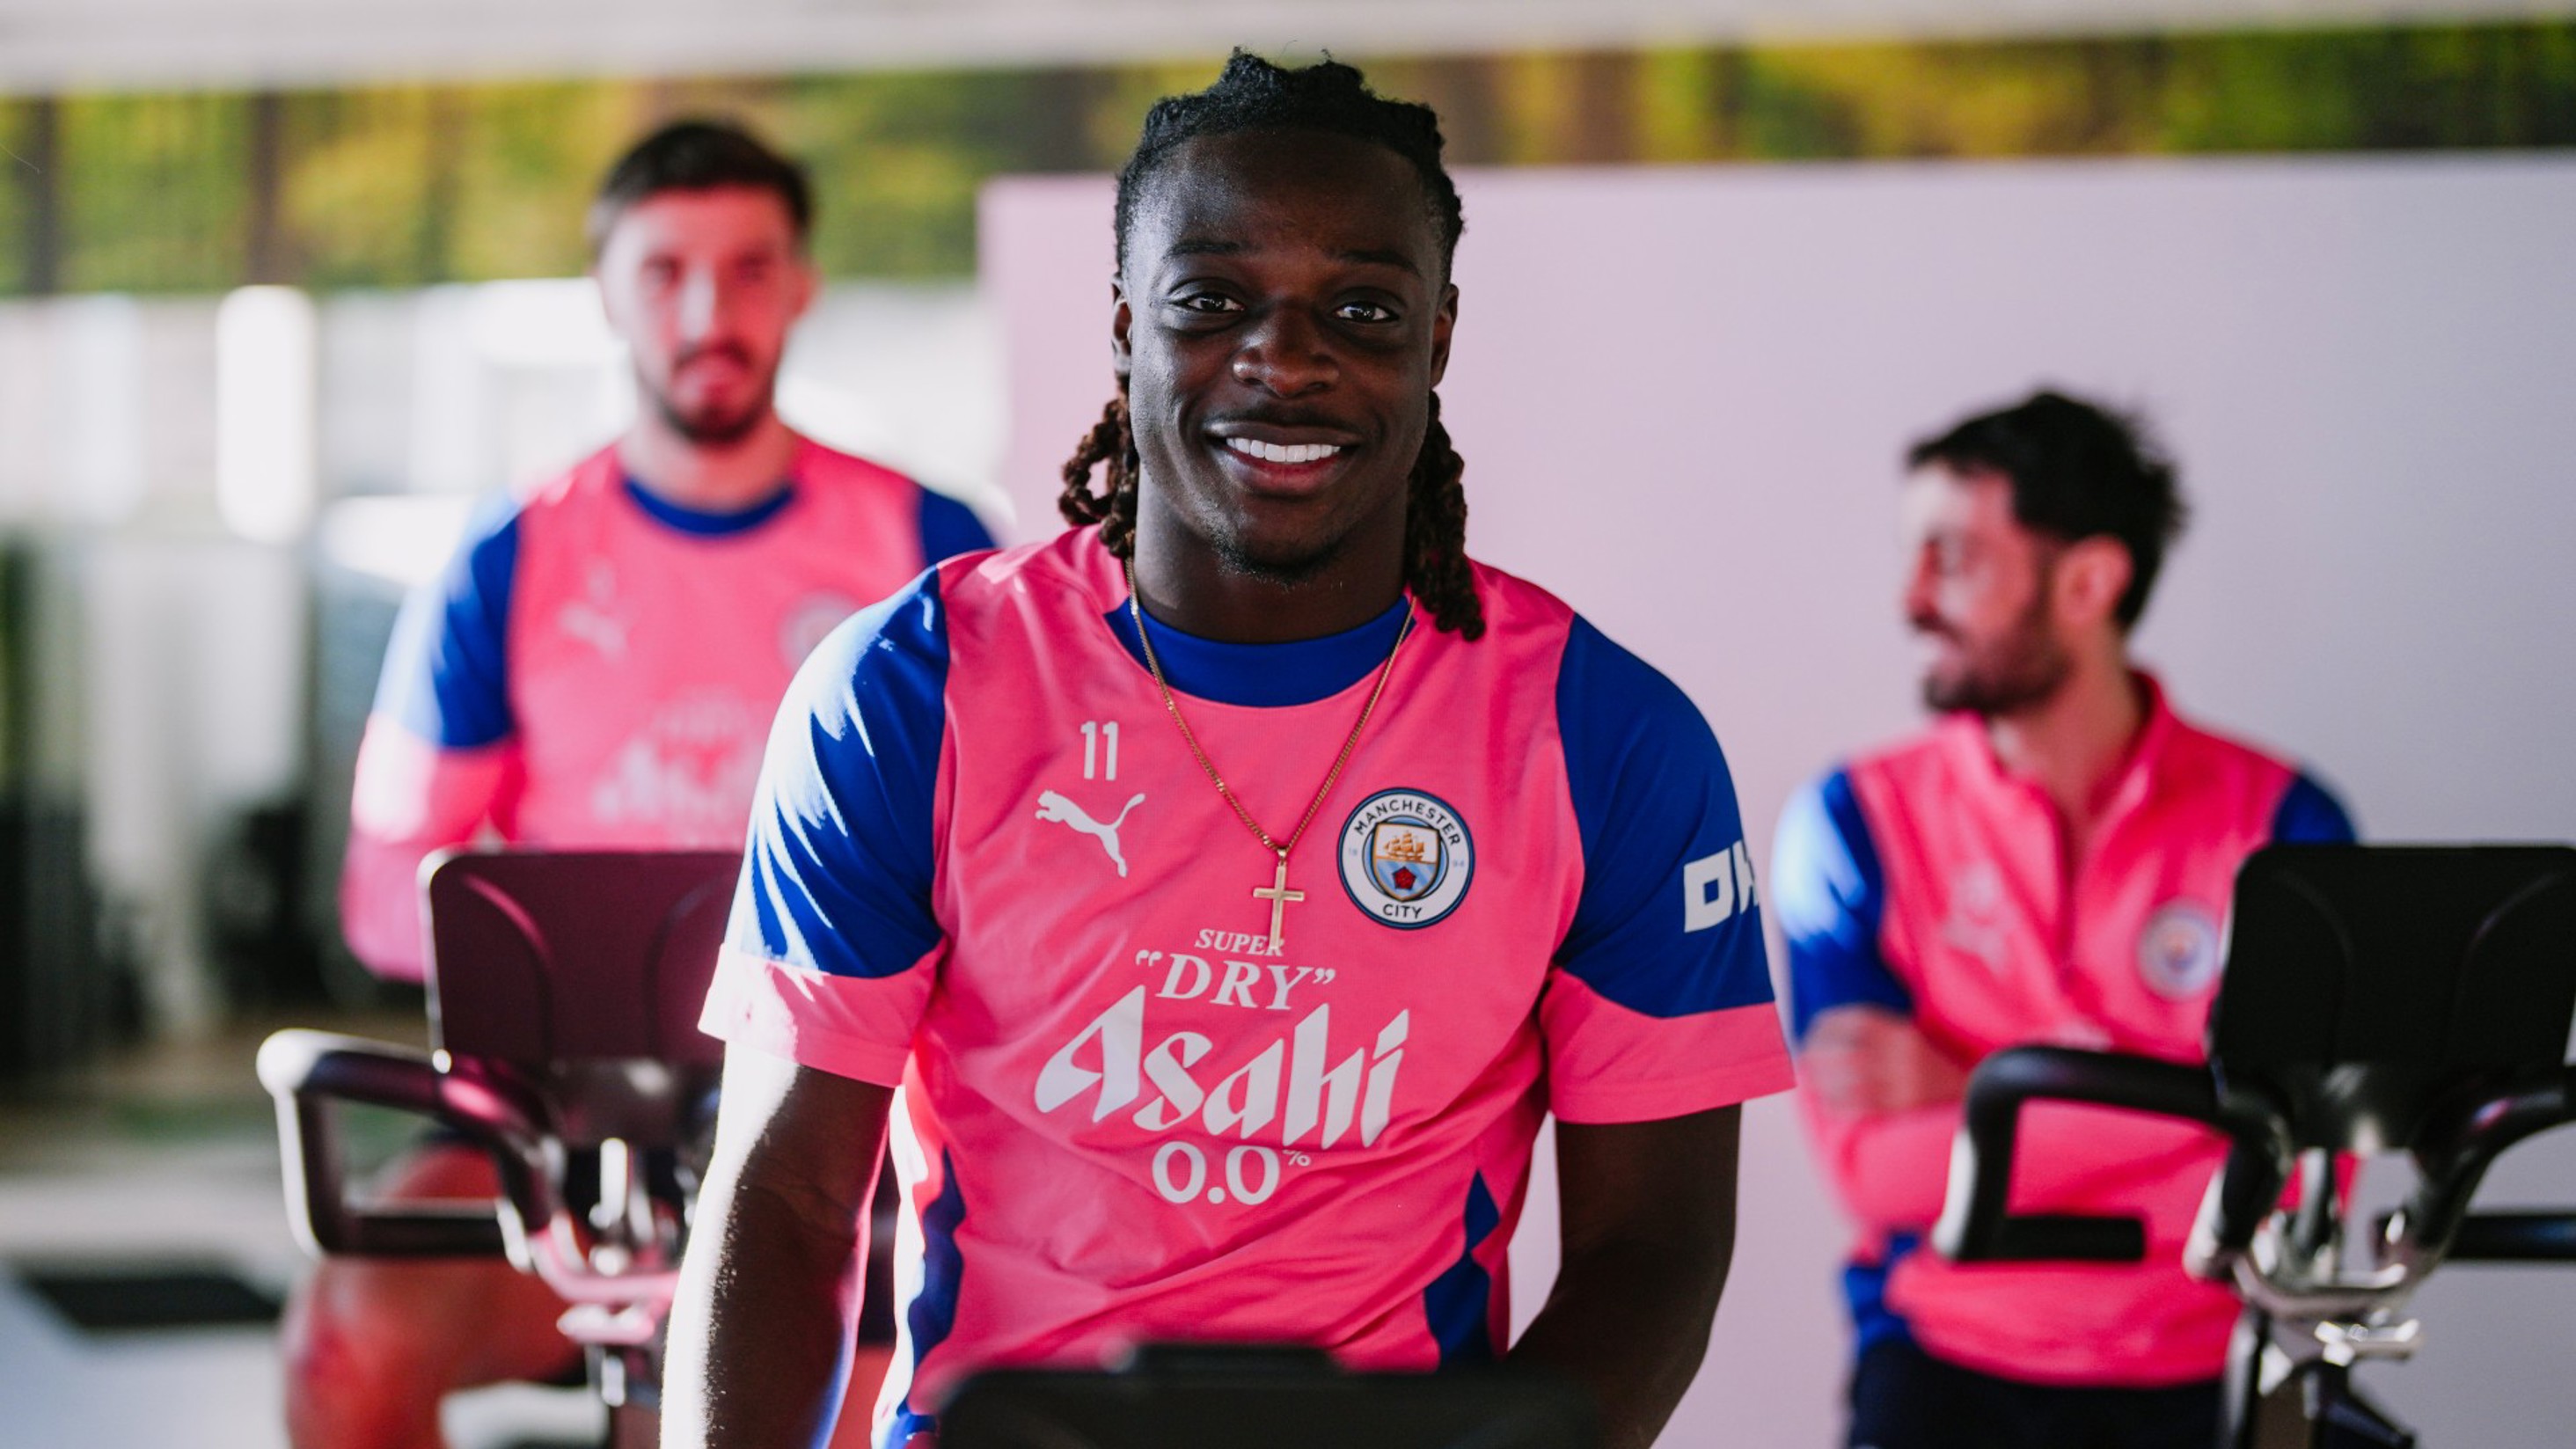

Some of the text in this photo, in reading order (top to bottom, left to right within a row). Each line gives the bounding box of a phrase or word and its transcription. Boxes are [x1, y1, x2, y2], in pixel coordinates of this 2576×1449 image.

[1080, 721, 1118, 780] 11
[1354, 799, 1460, 845] MANCHESTER
[1383, 904, 1423, 919] CITY
[1034, 984, 1409, 1149] Asahi
